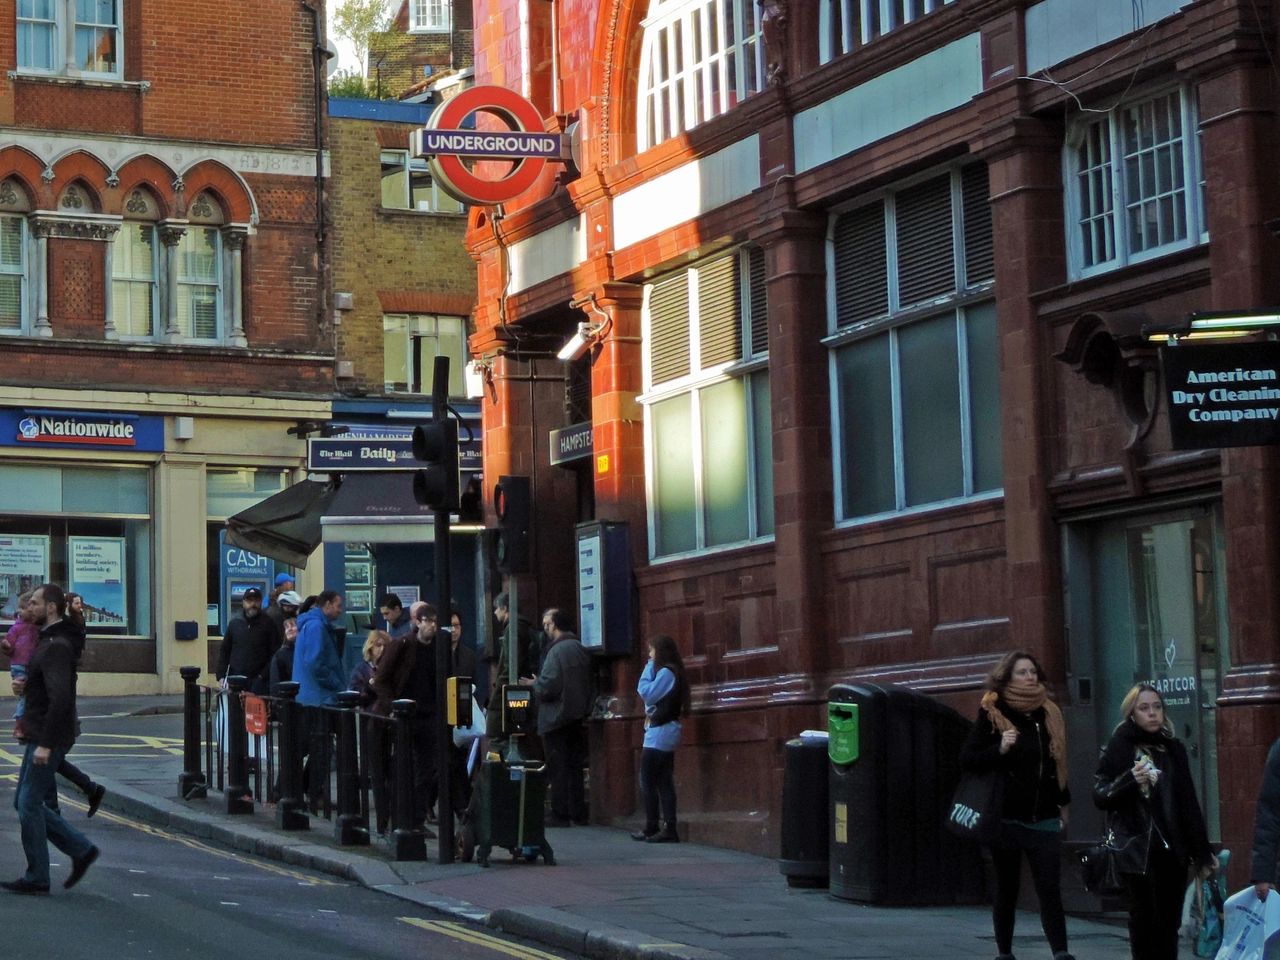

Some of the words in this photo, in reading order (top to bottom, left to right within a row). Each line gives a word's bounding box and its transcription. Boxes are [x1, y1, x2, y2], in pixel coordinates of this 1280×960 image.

[427, 134, 556, 153] UNDERGROUND
[1186, 367, 1277, 384] American
[1172, 390, 1205, 405] Dry
[1209, 386, 1280, 402] Cleanin
[1188, 407, 1280, 422] Company
[39, 415, 134, 438] Nationwide
[560, 429, 594, 454] HAMPSTE
[360, 446, 397, 463] Daily
[226, 548, 268, 567] CASH
[227, 566, 268, 575] WITHDRAWALS
[1143, 676, 1196, 693] EARTCOR
[508, 700, 529, 709] WAIT
